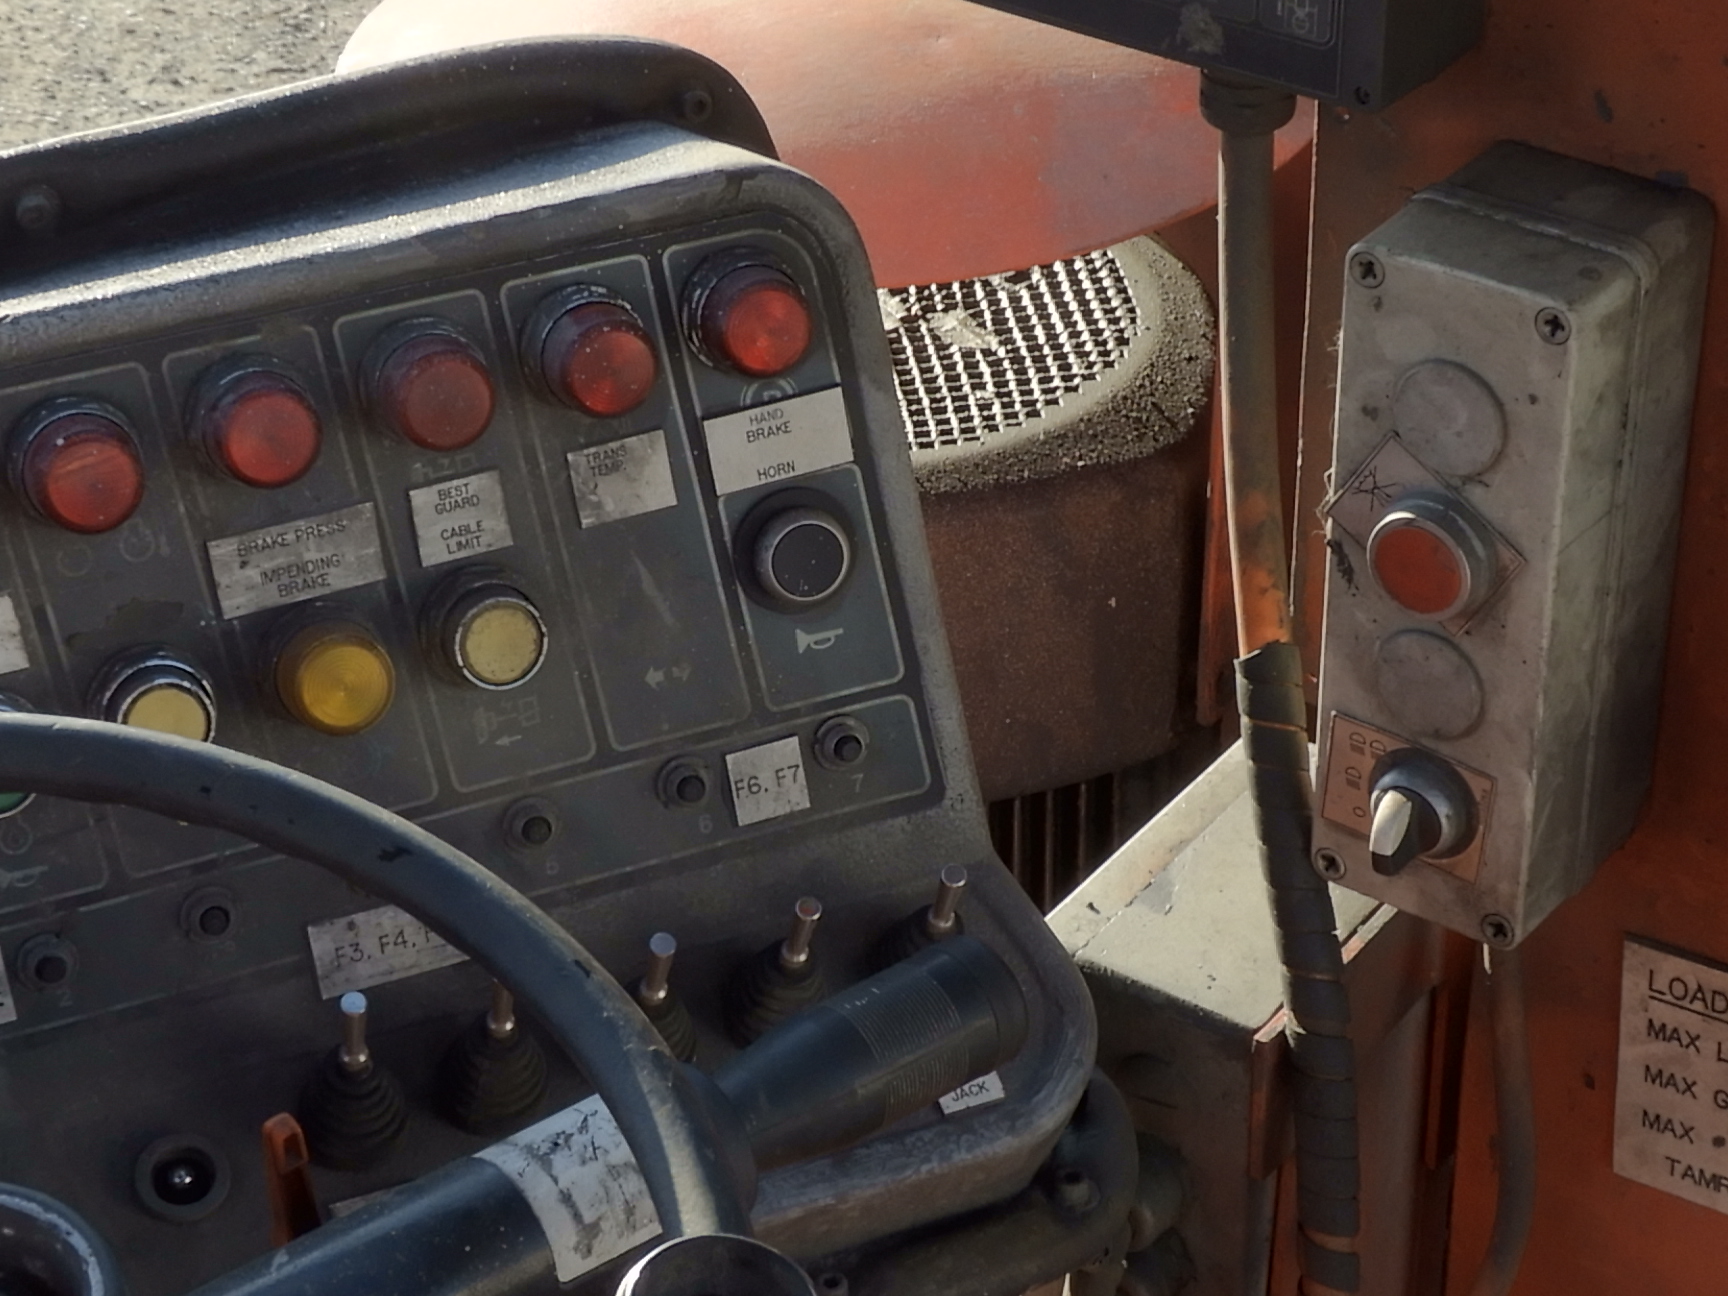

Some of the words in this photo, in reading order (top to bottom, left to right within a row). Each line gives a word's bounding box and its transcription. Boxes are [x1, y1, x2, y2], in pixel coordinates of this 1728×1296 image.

[749, 408, 783, 426] HAND
[746, 421, 792, 443] BRAKE
[586, 445, 626, 465] TRANS
[757, 460, 796, 481] HORN
[438, 483, 470, 501] BEST
[435, 494, 480, 515] GUARD
[237, 532, 290, 557] BRAKE
[294, 520, 345, 544] PRESS
[440, 520, 484, 541] CABLE
[446, 536, 482, 555] LIMIT
[260, 553, 340, 585] IMPENDING
[278, 573, 331, 598] BRAKE
[776, 765, 802, 788] F7
[851, 773, 864, 793] 7
[1647, 1019, 1701, 1054] MAX
[952, 1080, 990, 1102] JACK
[1643, 1064, 1698, 1100] MAX
[1642, 1109, 1696, 1145] MAX
